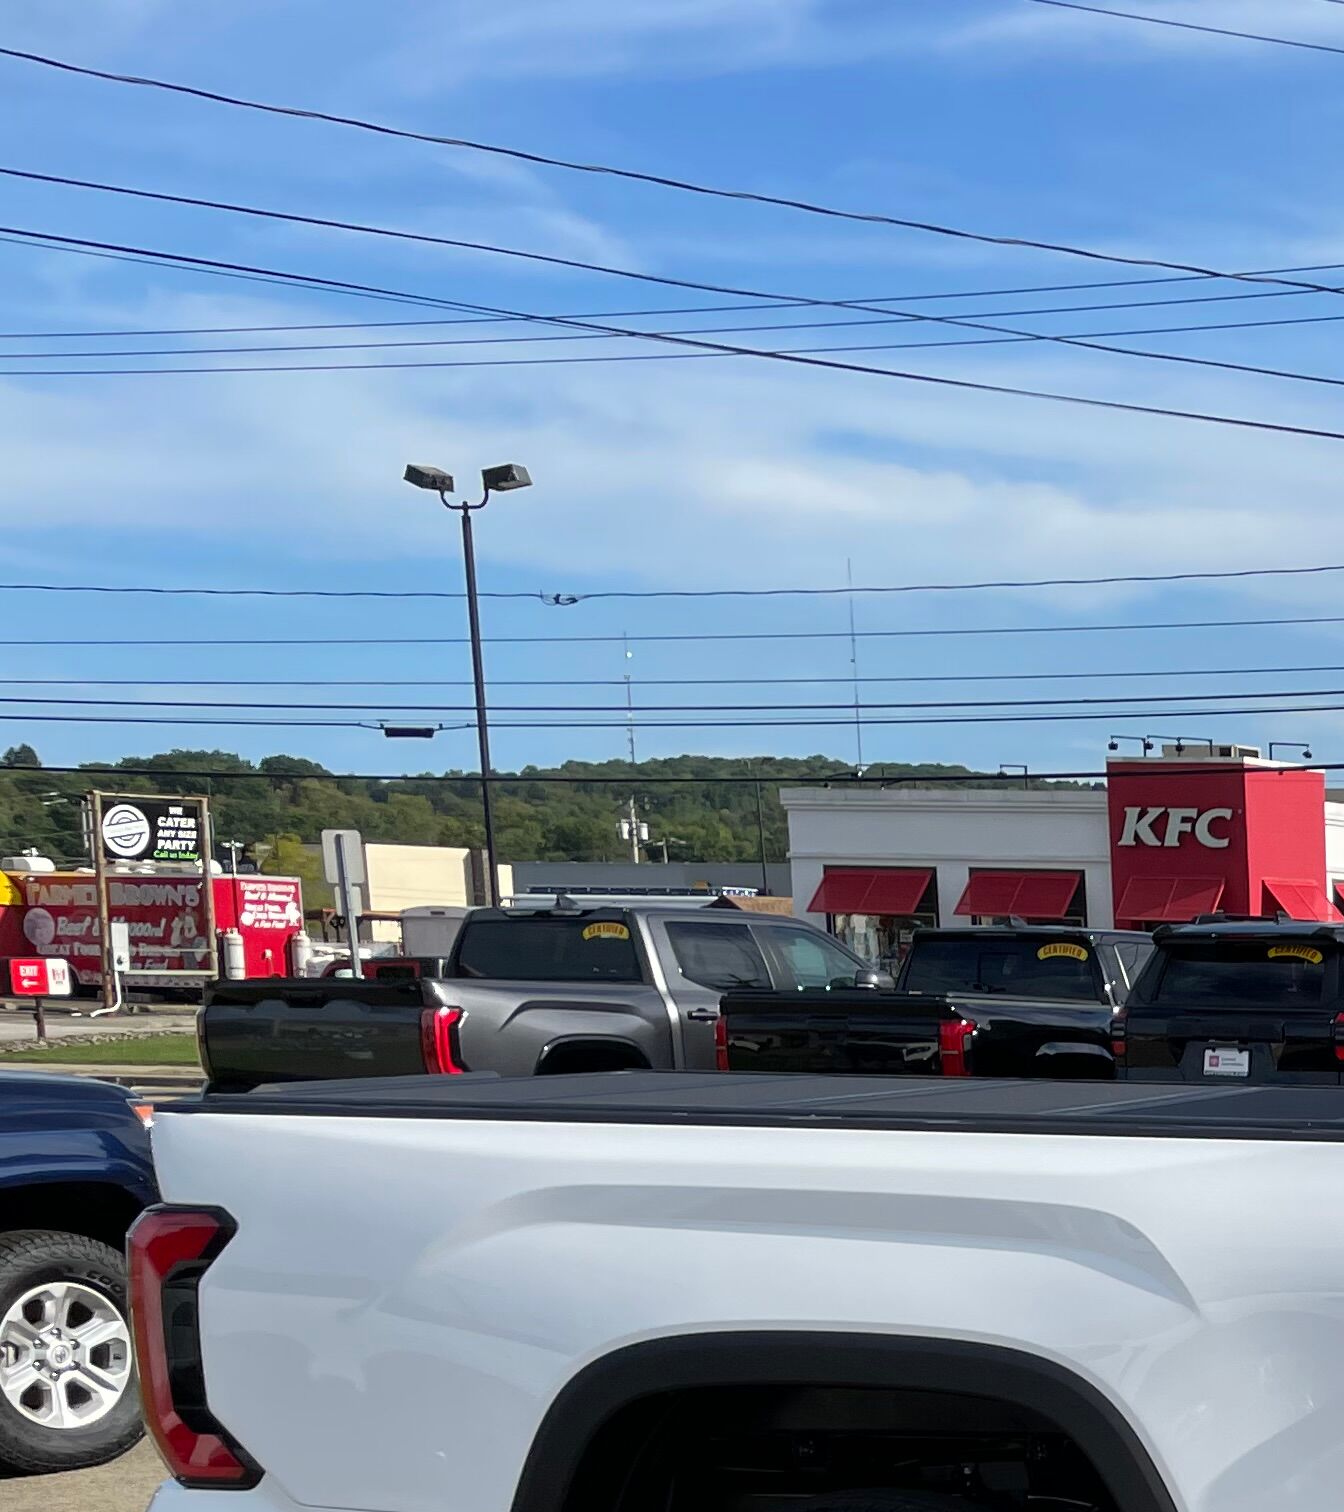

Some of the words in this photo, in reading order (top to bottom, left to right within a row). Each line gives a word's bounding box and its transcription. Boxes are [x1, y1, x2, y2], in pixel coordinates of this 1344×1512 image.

[157, 816, 196, 829] CATER
[1117, 806, 1233, 848] KFC
[157, 829, 176, 838] ANY
[157, 839, 196, 850] PARTY
[1043, 944, 1083, 958] CERTIFIED
